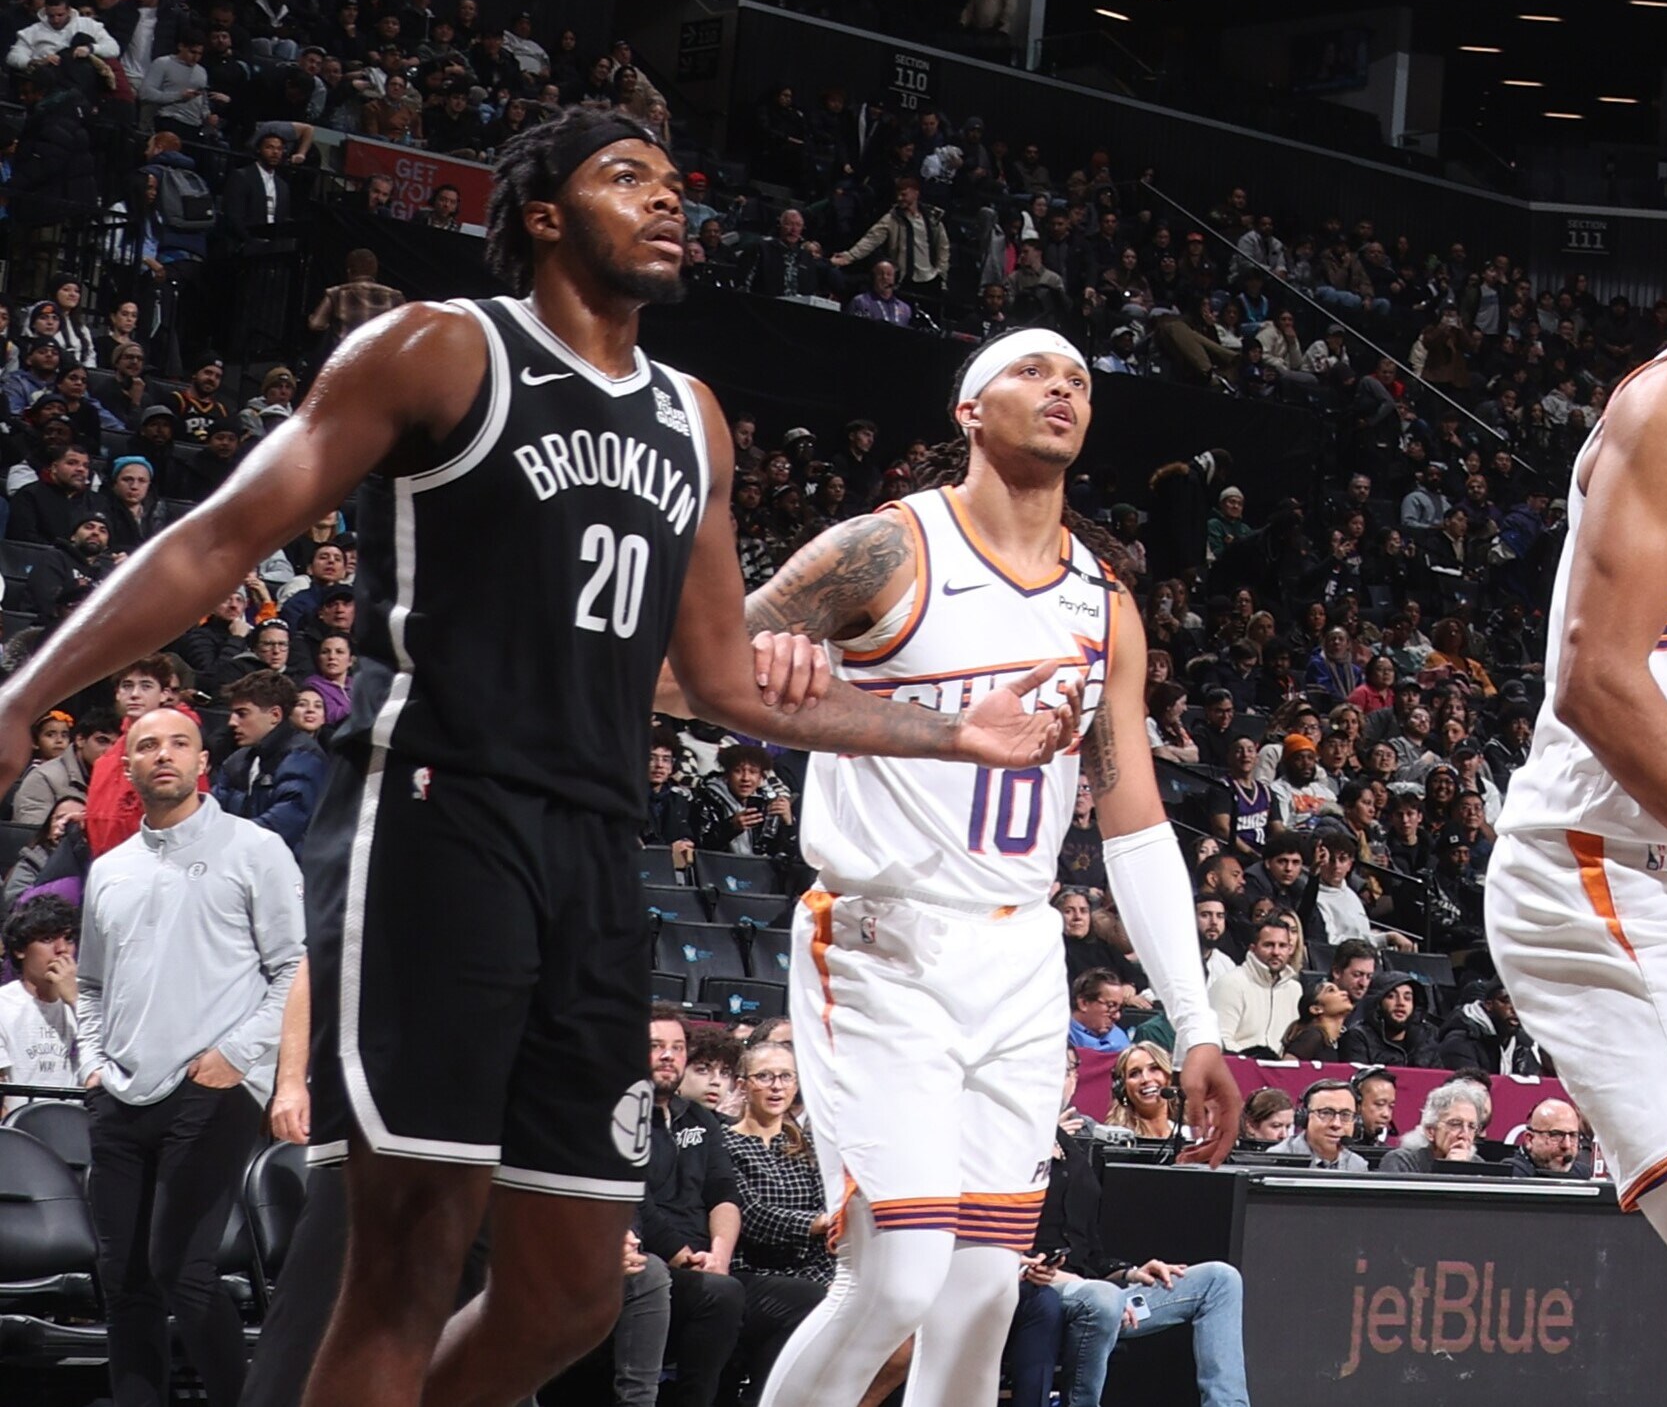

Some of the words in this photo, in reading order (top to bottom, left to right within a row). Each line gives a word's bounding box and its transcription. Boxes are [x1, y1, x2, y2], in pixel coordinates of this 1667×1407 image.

[895, 54, 930, 70] SECTION
[894, 67, 928, 91] 110
[900, 94, 918, 110] 10
[395, 158, 438, 183] GET
[1567, 218, 1607, 230] SECTION
[1568, 231, 1605, 249] 111
[513, 428, 697, 535] BROOKLYN
[574, 523, 650, 639] 20
[1058, 594, 1099, 618] PayPal
[967, 764, 1044, 857] 10
[675, 1126, 707, 1149] Nets
[1340, 1258, 1574, 1378] jetBlue
